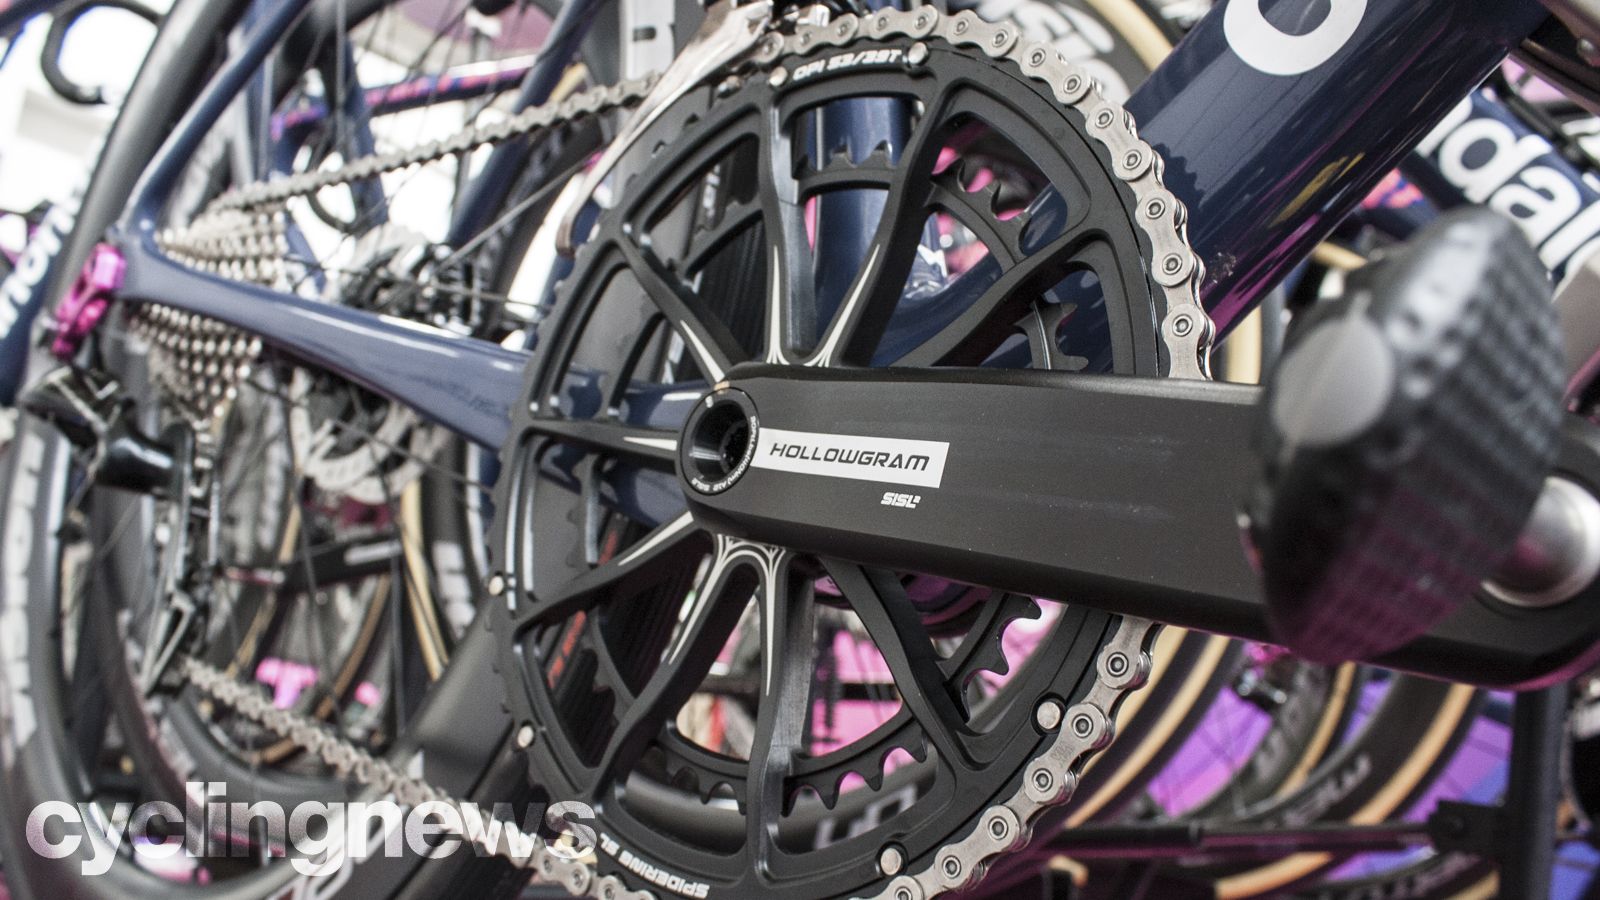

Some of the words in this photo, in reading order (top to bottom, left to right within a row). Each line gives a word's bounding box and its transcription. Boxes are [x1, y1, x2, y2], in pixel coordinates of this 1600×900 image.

[769, 442, 931, 472] HOLLOWGRAM
[599, 832, 620, 856] SL
[618, 849, 710, 899] SPIDERING
